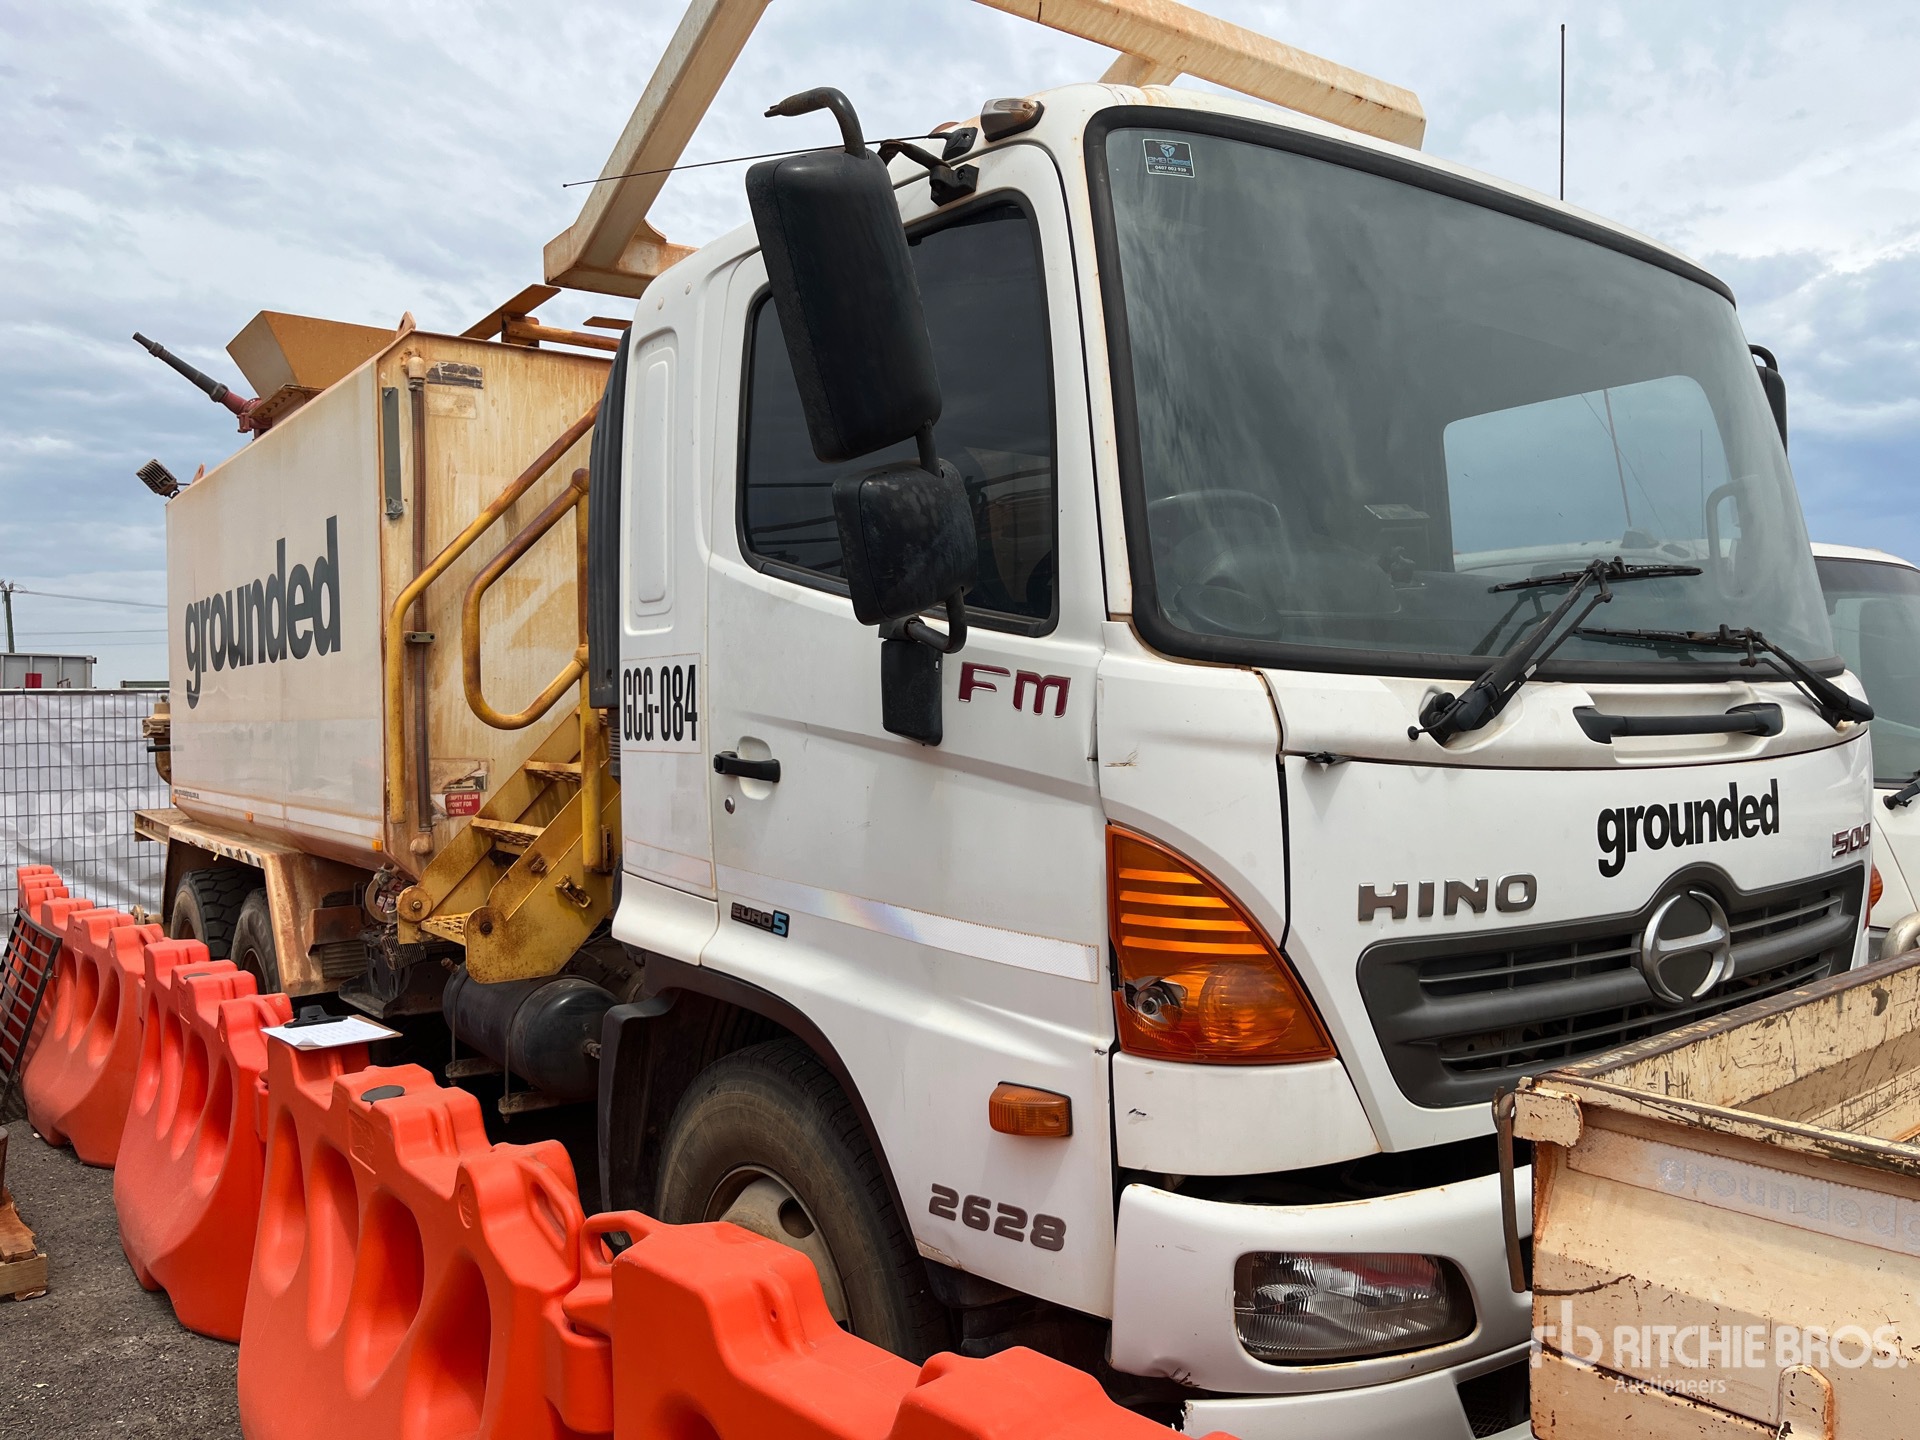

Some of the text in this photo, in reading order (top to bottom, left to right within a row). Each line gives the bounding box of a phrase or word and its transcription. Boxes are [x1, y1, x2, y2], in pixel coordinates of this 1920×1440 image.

[185, 515, 341, 709] grounded
[623, 664, 698, 742] GCG-084
[957, 662, 1071, 718] FM
[1598, 778, 1780, 878] grounded
[1831, 822, 1871, 858] 500
[1357, 872, 1538, 922] HINO
[928, 1182, 1067, 1252] 2628
